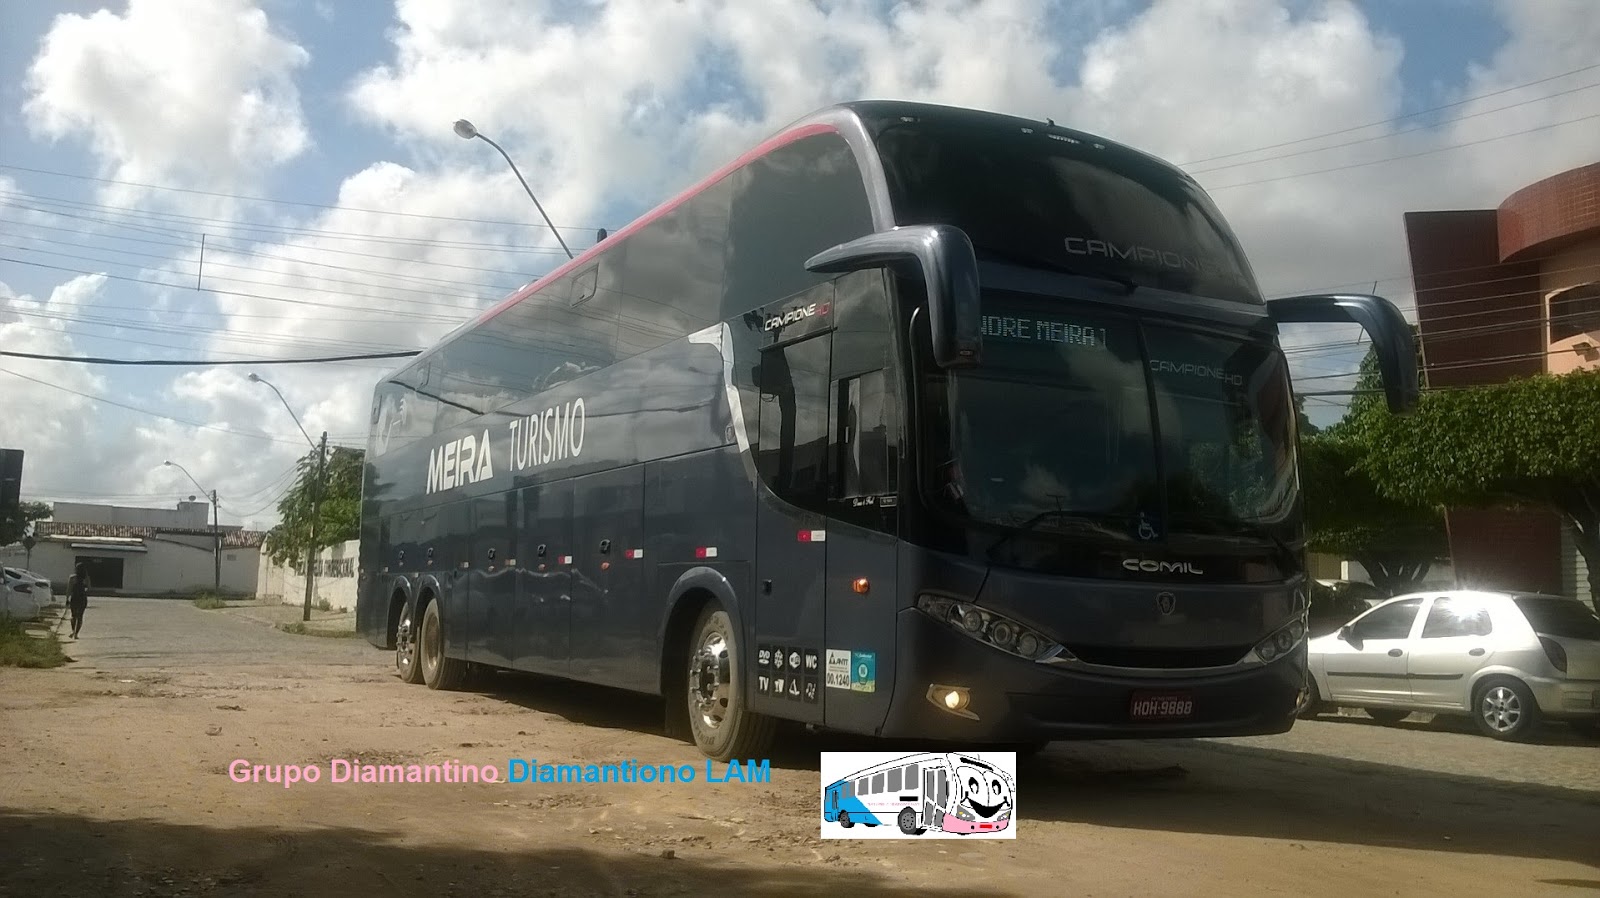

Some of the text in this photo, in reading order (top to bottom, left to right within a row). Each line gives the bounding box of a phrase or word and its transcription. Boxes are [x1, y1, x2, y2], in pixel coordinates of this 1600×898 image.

[1064, 237, 1202, 271] CAMPION
[1036, 320, 1095, 347] MEIRA
[426, 397, 585, 495] MEIRA TURISMO
[1122, 558, 1203, 575] COMIL
[805, 654, 818, 670] WC
[758, 676, 770, 692] TV
